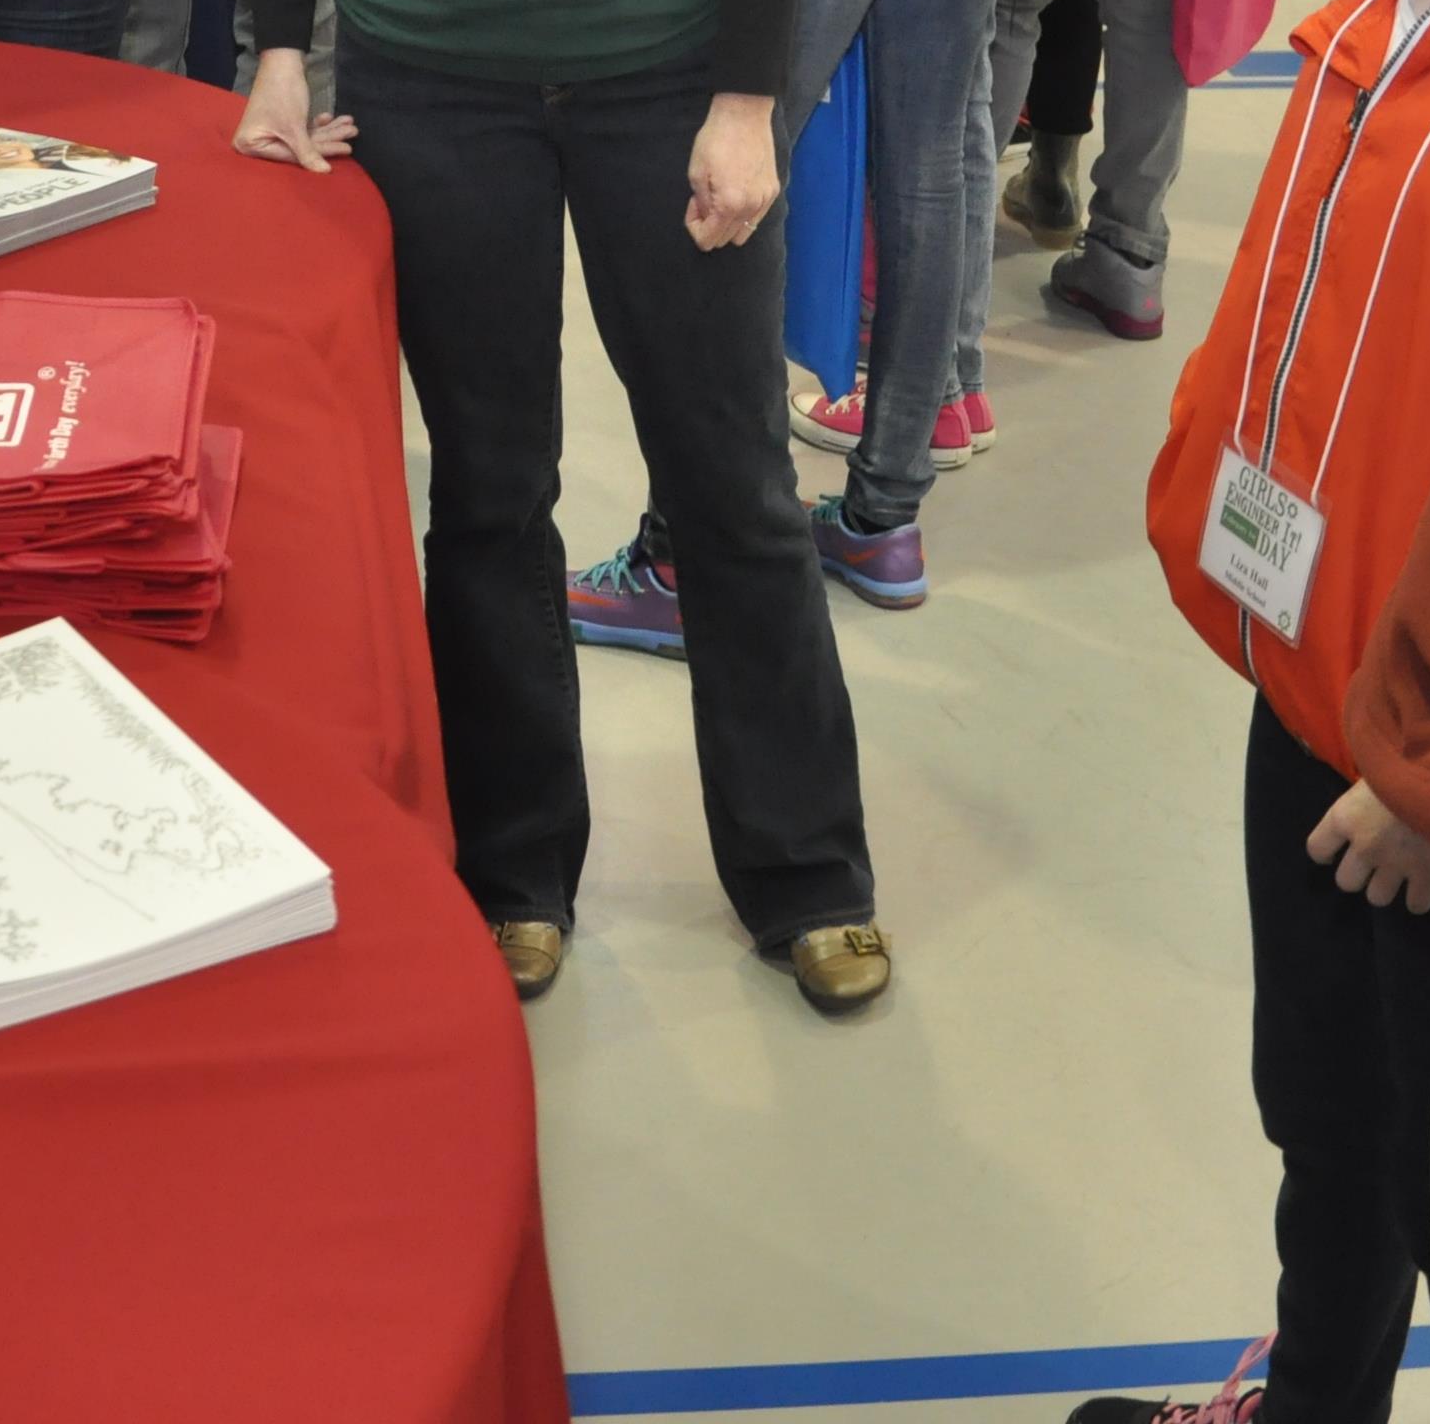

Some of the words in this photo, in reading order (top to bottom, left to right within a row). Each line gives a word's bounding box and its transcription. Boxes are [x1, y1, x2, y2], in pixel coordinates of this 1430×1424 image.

[1225, 481, 1280, 533] ENGINEER
[1239, 466, 1289, 518] GIRLS
[1259, 531, 1291, 573] DAY
